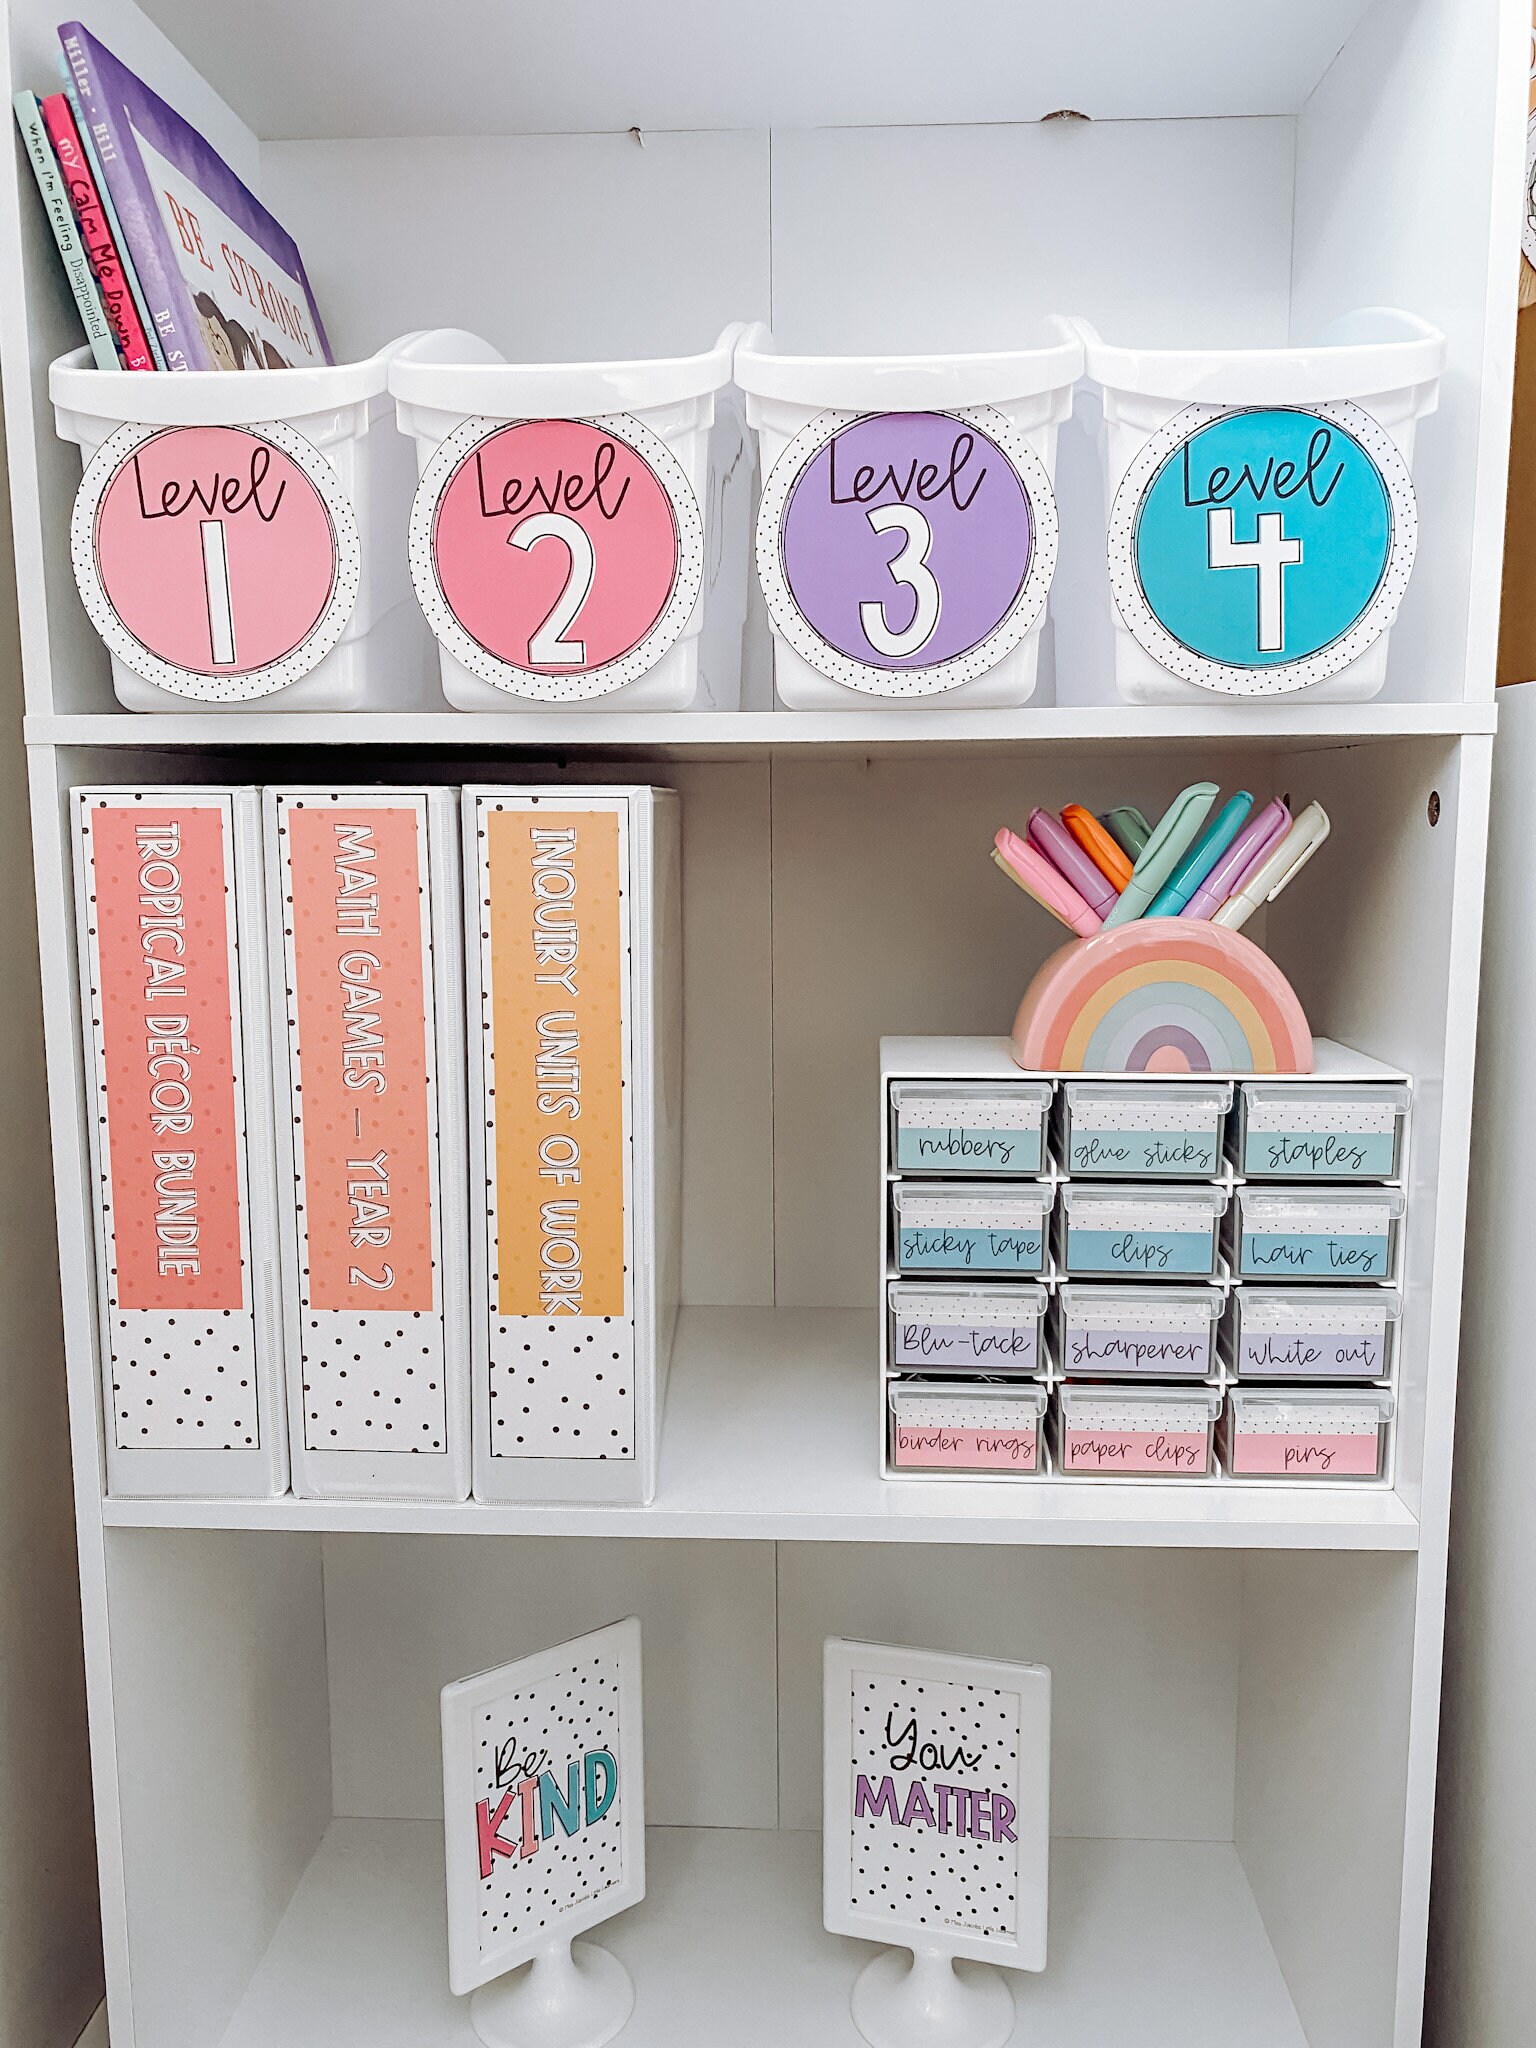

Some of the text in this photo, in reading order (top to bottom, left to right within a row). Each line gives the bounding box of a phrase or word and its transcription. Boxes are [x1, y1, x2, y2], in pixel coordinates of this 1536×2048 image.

[63, 36, 92, 97] Miller
[92, 122, 118, 164] Hill
[58, 138, 81, 169] my
[69, 179, 98, 235] Calm
[51, 198, 73, 252] Feeling
[70, 258, 107, 340] Disappointed
[90, 243, 112, 279] Me
[163, 190, 313, 357] BE STRONG
[106, 289, 131, 348] Down
[154, 308, 176, 337] BE
[132, 446, 286, 522] Level
[475, 442, 631, 520] Level
[829, 433, 986, 511] Level
[1183, 428, 1346, 507] Level
[200, 518, 236, 666] 1
[506, 511, 588, 666] 2
[858, 503, 942, 659] 3
[1206, 507, 1302, 653] 4
[333, 823, 381, 936] MATH
[133, 821, 200, 1278] TROPICAL DÉCOR BUNDLE
[337, 949, 387, 1097] GAMES
[529, 826, 582, 1315] INQUIRY UNITS OF WORK
[919, 1128, 1015, 1164] rubbers
[1074, 1138, 1213, 1168] glue sticks
[1267, 1136, 1368, 1169] staples
[346, 1149, 392, 1250] YEAR
[903, 1229, 1041, 1265] sticky tape
[1111, 1233, 1173, 1268] clips
[1251, 1237, 1378, 1272] hair ties
[348, 1266, 394, 1291] 2
[903, 1324, 1031, 1356] Blu-tack
[1071, 1332, 1203, 1367] sharpener
[1248, 1337, 1376, 1366] white out
[898, 1427, 1035, 1460] binder rings
[1071, 1435, 1200, 1466] paper clips
[1284, 1445, 1336, 1470] pins
[494, 1736, 549, 1790] Be
[885, 1710, 983, 1771] You
[475, 1748, 618, 1880] KIND
[854, 1774, 1018, 1844] MATTER
